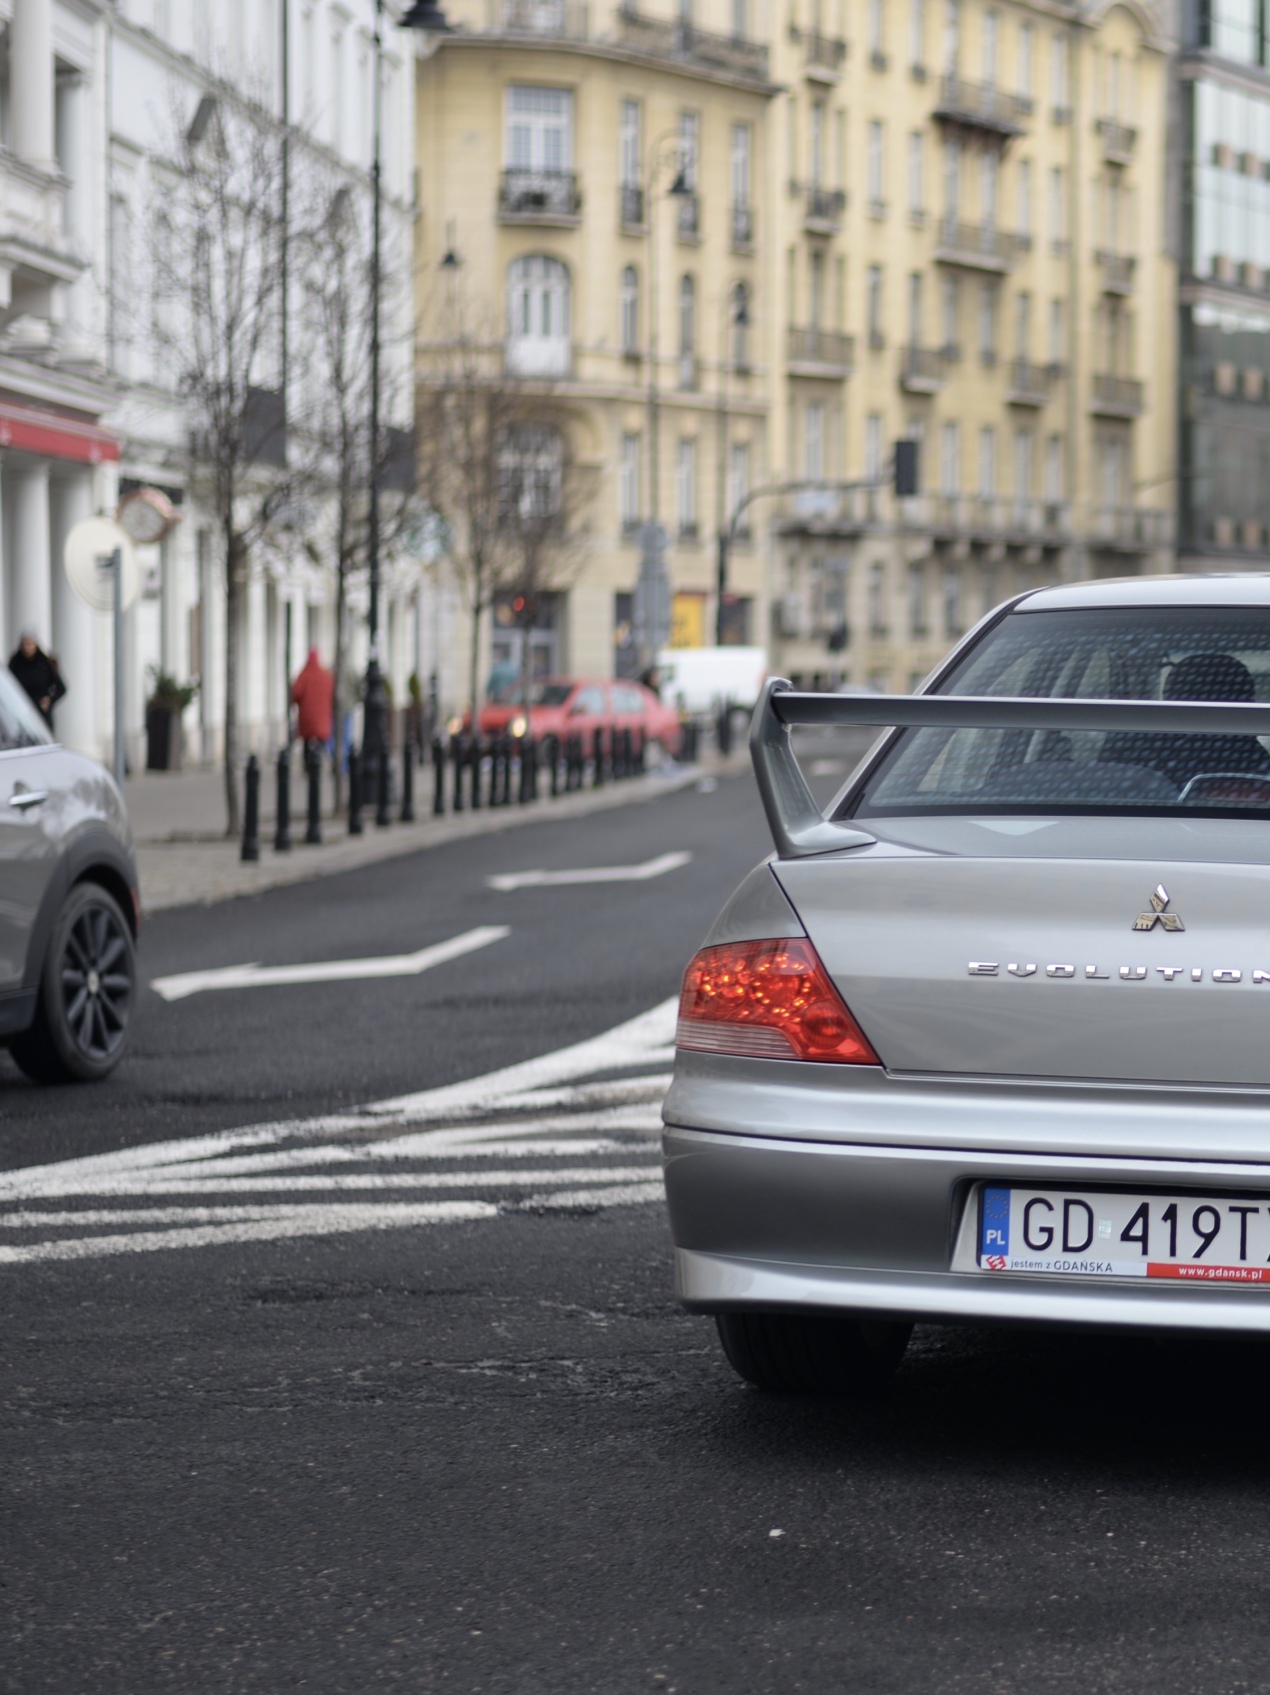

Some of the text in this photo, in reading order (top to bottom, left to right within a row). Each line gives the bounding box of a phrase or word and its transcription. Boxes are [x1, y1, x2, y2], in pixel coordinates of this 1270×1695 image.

[1023, 1197, 1094, 1253] GD
[986, 1229, 1006, 1246] PL
[1010, 1258, 1113, 1273] jestem z GDAŃSKA
[1178, 1266, 1263, 1280] www.gdansk.pl
